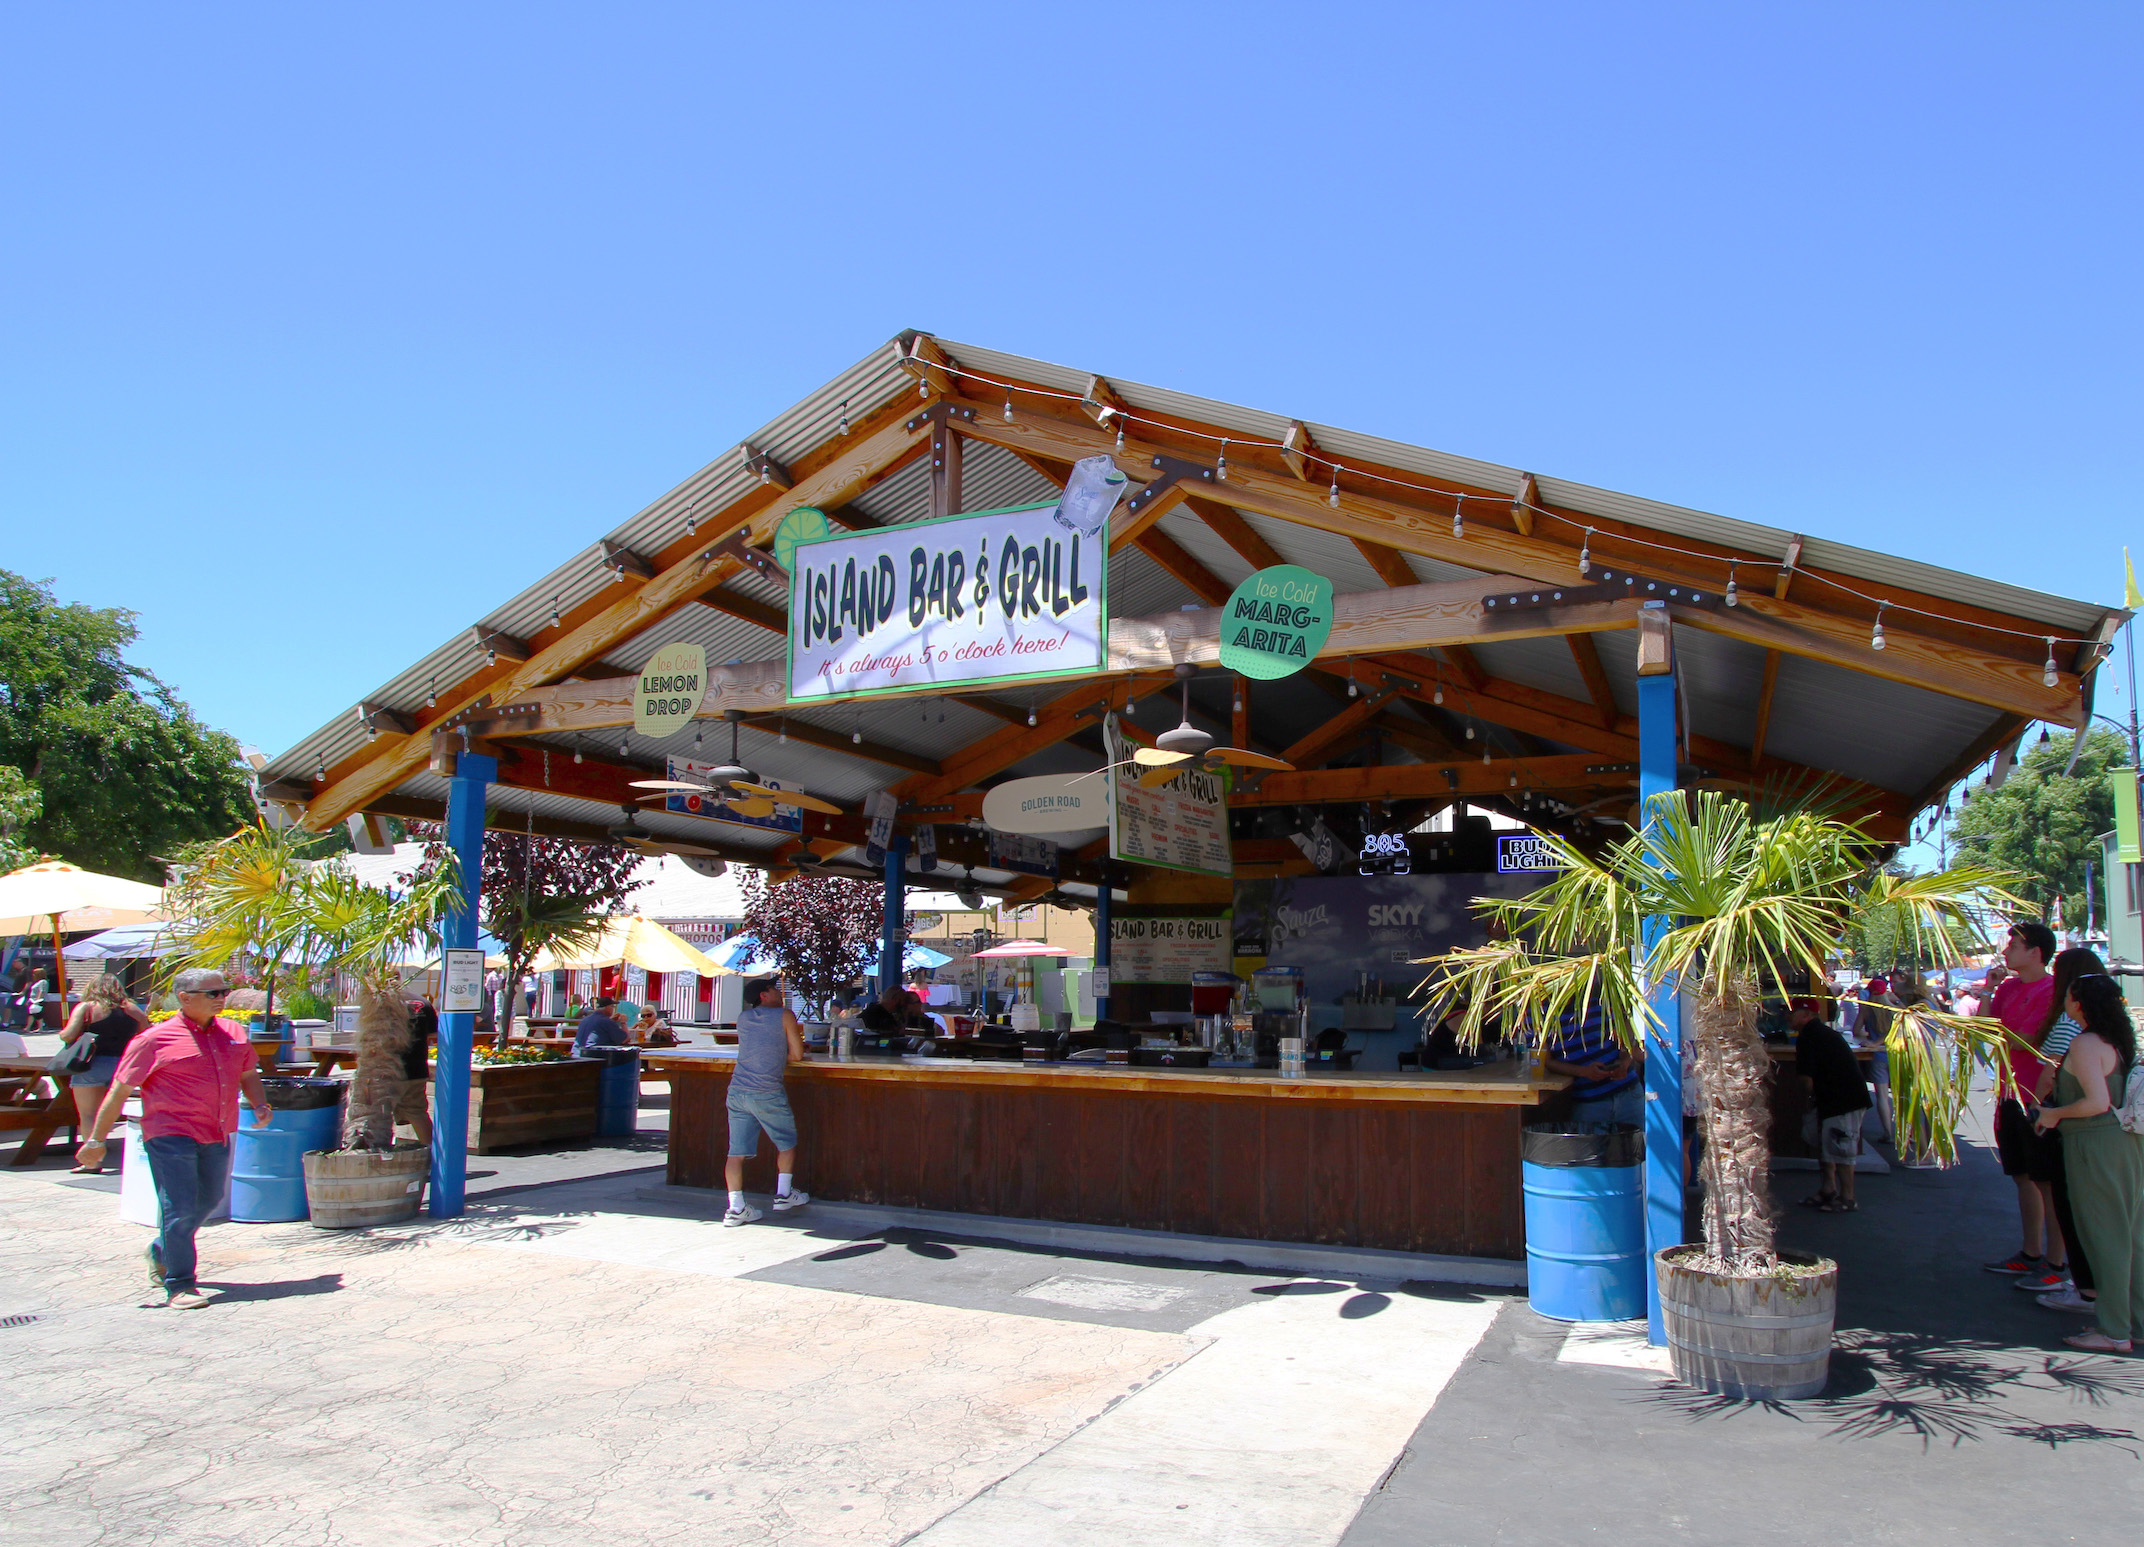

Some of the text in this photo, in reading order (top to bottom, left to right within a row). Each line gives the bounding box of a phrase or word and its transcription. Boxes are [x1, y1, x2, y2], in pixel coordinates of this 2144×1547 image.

[804, 533, 1089, 648] ISLAND BAR & GRILL
[1256, 577, 1318, 605] Ice Cold
[1233, 597, 1321, 629] MARG-
[817, 629, 1070, 678] It's always 5 o'clock here!
[1231, 626, 1307, 658] ARITA
[657, 654, 698, 671] Ice Cold
[642, 674, 698, 693] LEMON
[646, 697, 692, 715] DROP
[1188, 768, 1219, 805] GRILL
[1021, 795, 1081, 812] GOLDEN ROAD
[1364, 833, 1406, 853] 805
[1272, 904, 1329, 941] Sauza
[1367, 904, 1425, 927] SKYY
[1150, 920, 1174, 939] BAR
[1187, 920, 1223, 940] GRILL
[1367, 928, 1425, 942] VODKA
